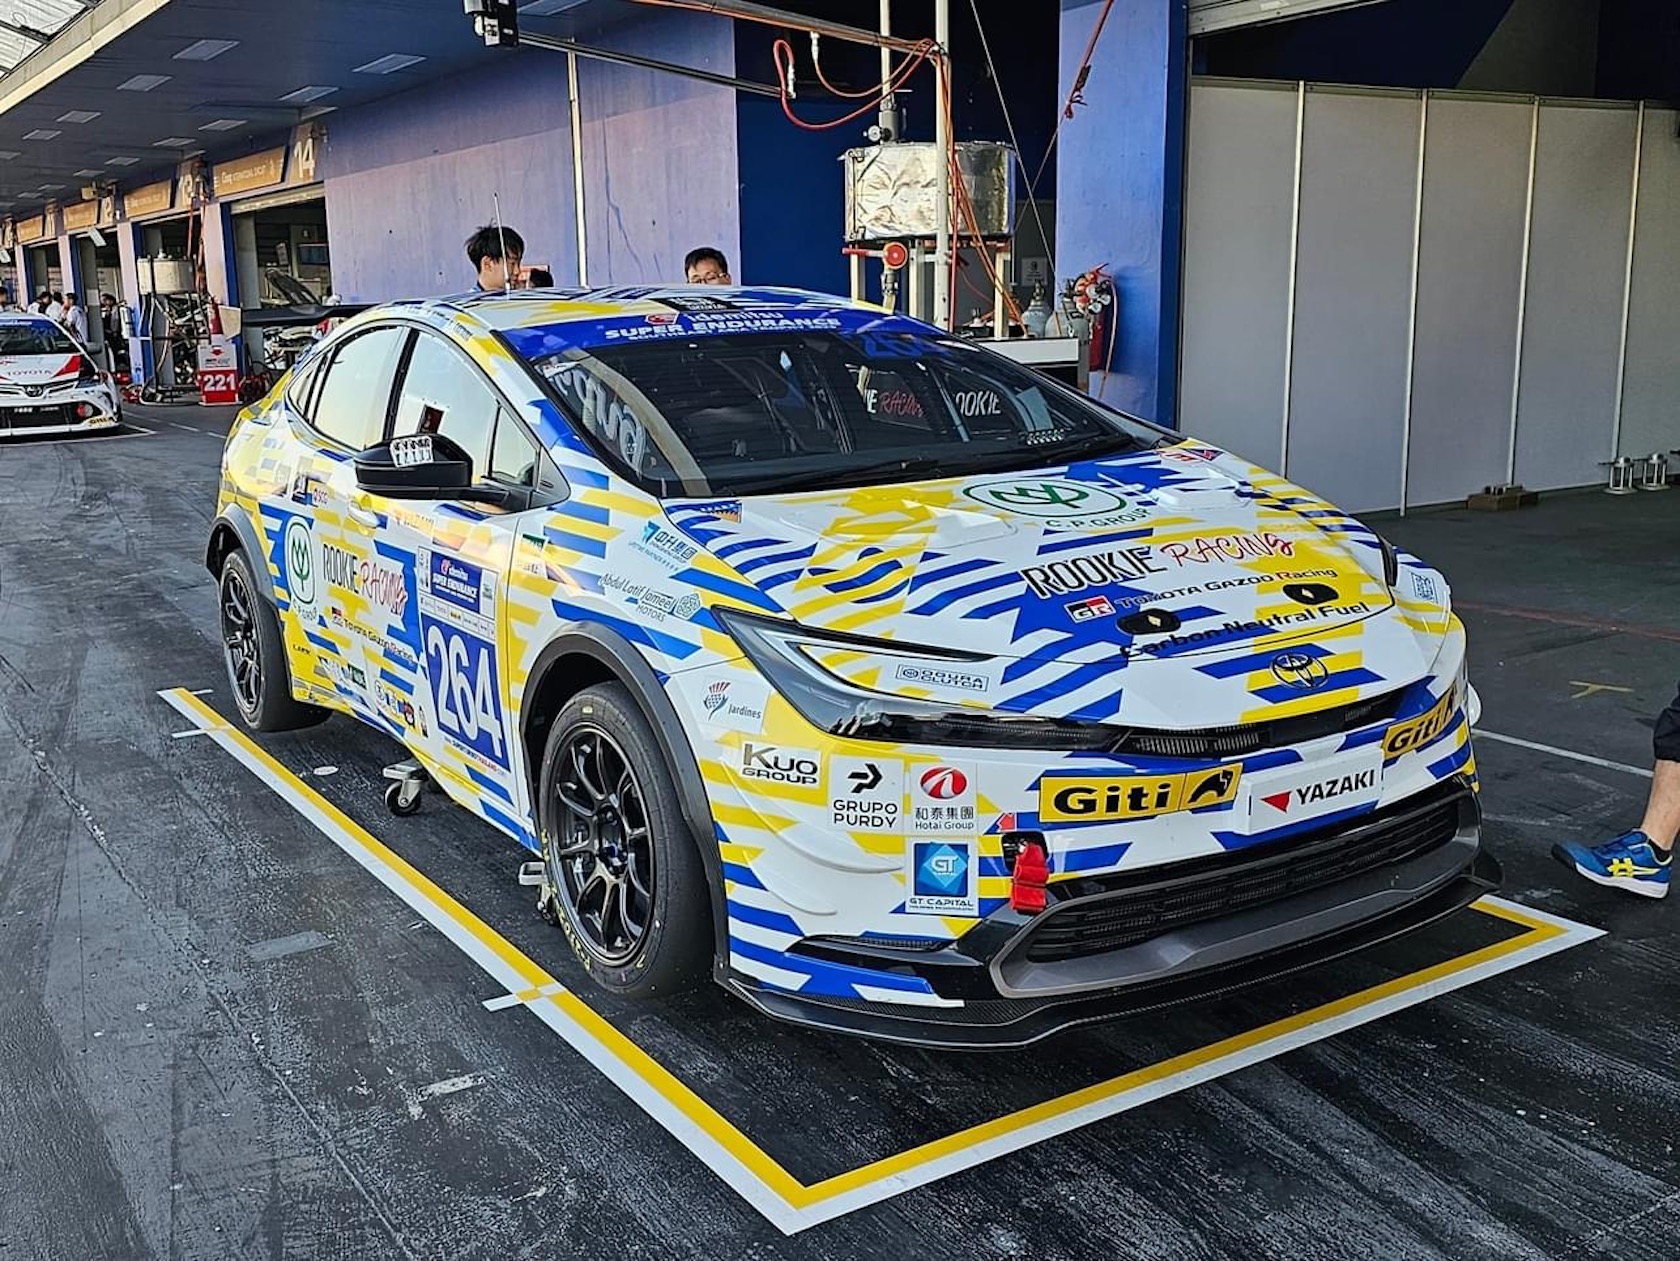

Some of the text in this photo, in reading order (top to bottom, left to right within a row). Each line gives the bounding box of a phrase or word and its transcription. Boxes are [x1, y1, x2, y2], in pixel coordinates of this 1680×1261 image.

[294, 138, 315, 178] 14
[605, 317, 842, 339] SUPER ENDURANCE
[203, 373, 236, 391] 221
[323, 543, 359, 594] ROOKIE
[1021, 547, 1167, 598] ROOKIE
[1204, 575, 1274, 591] GAZOO
[1276, 568, 1338, 580] Racing
[601, 573, 626, 590] Abdul
[640, 588, 675, 611] Jameel
[636, 604, 666, 622] MOTORS
[1072, 601, 1113, 619] GR
[1120, 602, 1370, 657] Carbon Neutral Fuel
[428, 625, 503, 758] 264
[1388, 708, 1441, 752] Giti
[742, 768, 817, 785] GROUP
[1296, 769, 1374, 805] YAZAKI
[833, 800, 898, 815] GRUPO
[1054, 782, 1171, 814] Giti
[834, 814, 897, 828] PURDY
[915, 806, 974, 820] 和泰集團
[915, 821, 974, 831] Hotai Group
[931, 855, 960, 874] GT
[926, 898, 974, 906] CAPITAL
